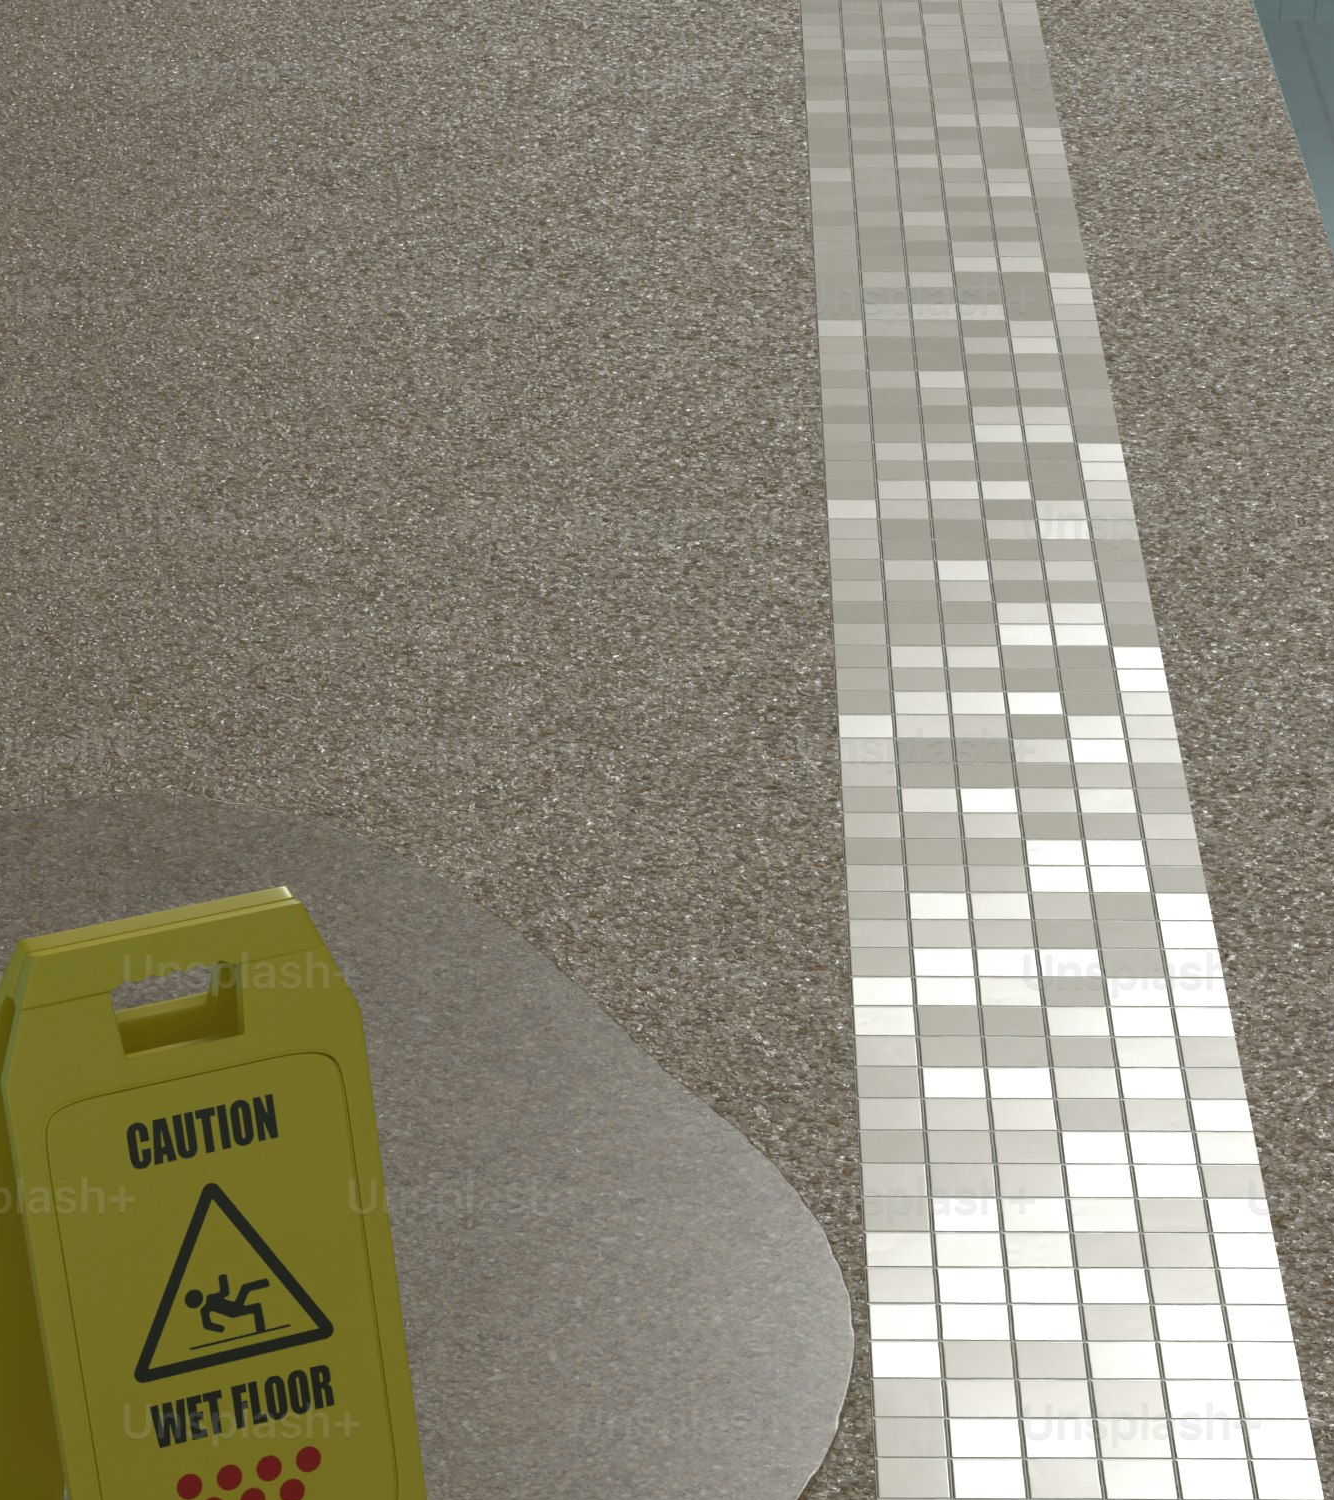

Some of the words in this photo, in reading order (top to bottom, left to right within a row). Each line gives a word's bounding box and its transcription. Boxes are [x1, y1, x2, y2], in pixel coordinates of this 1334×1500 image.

[126, 1093, 279, 1170] CAUTION
[149, 1389, 223, 1449] WET
[230, 1364, 335, 1430] FLOOR
